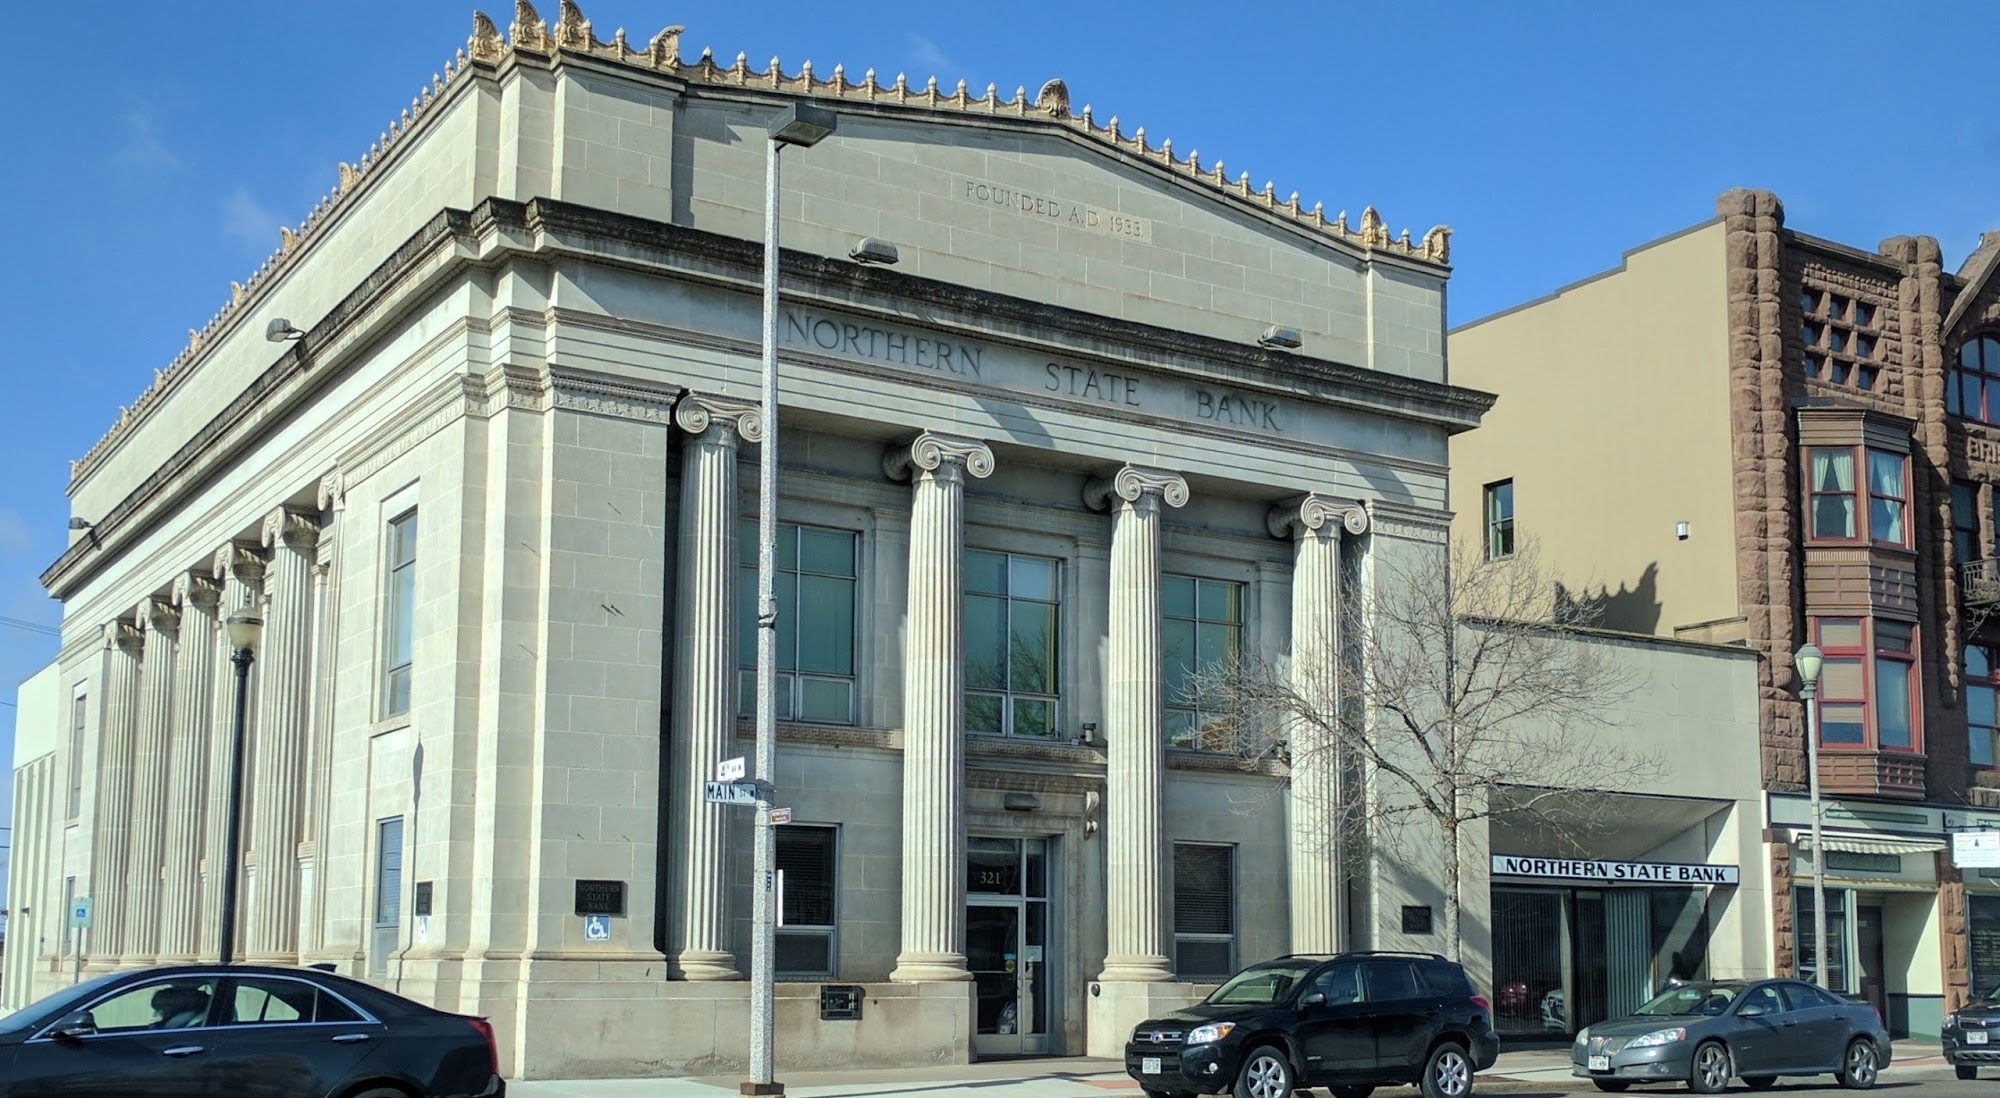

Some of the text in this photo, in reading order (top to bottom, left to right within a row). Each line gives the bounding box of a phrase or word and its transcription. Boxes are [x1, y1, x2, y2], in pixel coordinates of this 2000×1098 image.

[965, 181, 1061, 218] FOUNDED
[1068, 206, 1101, 228] A.D.
[785, 311, 1283, 432] NORTHERN STATE BANK
[1966, 436, 2000, 463] BRI
[707, 784, 735, 800] MAIN
[980, 871, 1001, 885] 321
[1505, 858, 1726, 881] NORTHERN STATE BANK
[578, 882, 621, 893] NORTHERN
[587, 893, 611, 902] STATE
